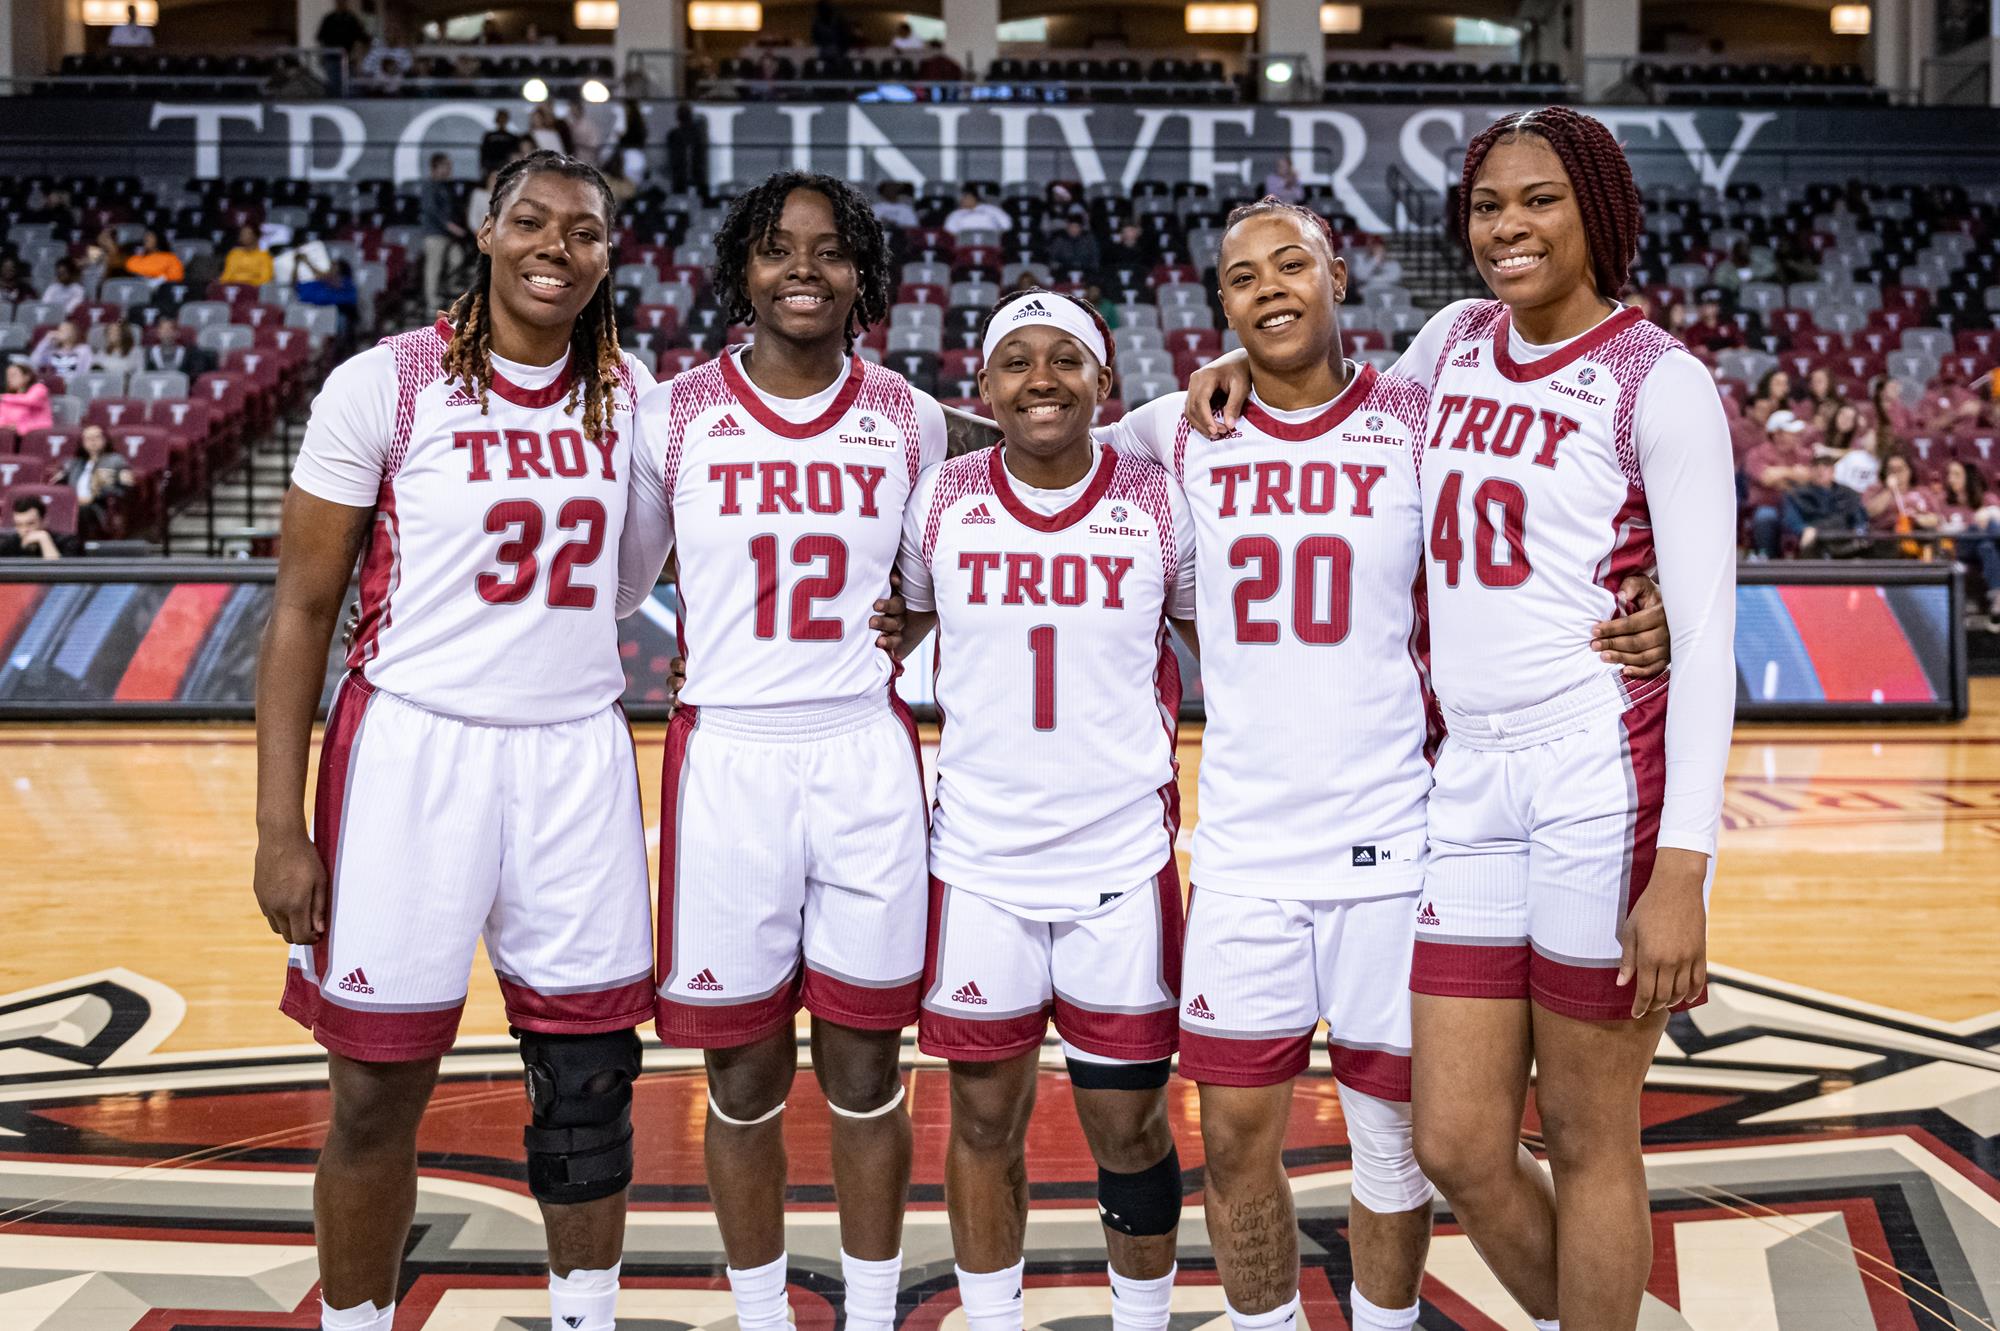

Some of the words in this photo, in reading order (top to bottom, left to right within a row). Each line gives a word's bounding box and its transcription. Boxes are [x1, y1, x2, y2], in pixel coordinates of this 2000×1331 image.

[1013, 310, 1052, 321] adidas
[452, 428, 620, 483] TROY
[708, 427, 745, 438] adidas
[1428, 393, 1582, 470] TROY
[708, 460, 887, 519] TROY
[1209, 460, 1388, 519] TROY
[961, 515, 996, 525] adidas
[1430, 470, 1533, 590] 40
[474, 496, 608, 611] 32
[957, 551, 1134, 610] TROY
[748, 532, 850, 642] 12
[1229, 533, 1354, 646] 20
[1028, 624, 1057, 732] 1
[1381, 850, 1391, 860] M
[339, 982, 375, 994] adidas
[687, 980, 724, 992] adidas
[951, 993, 988, 1006] adidas
[1186, 1007, 1215, 1021] adidas
